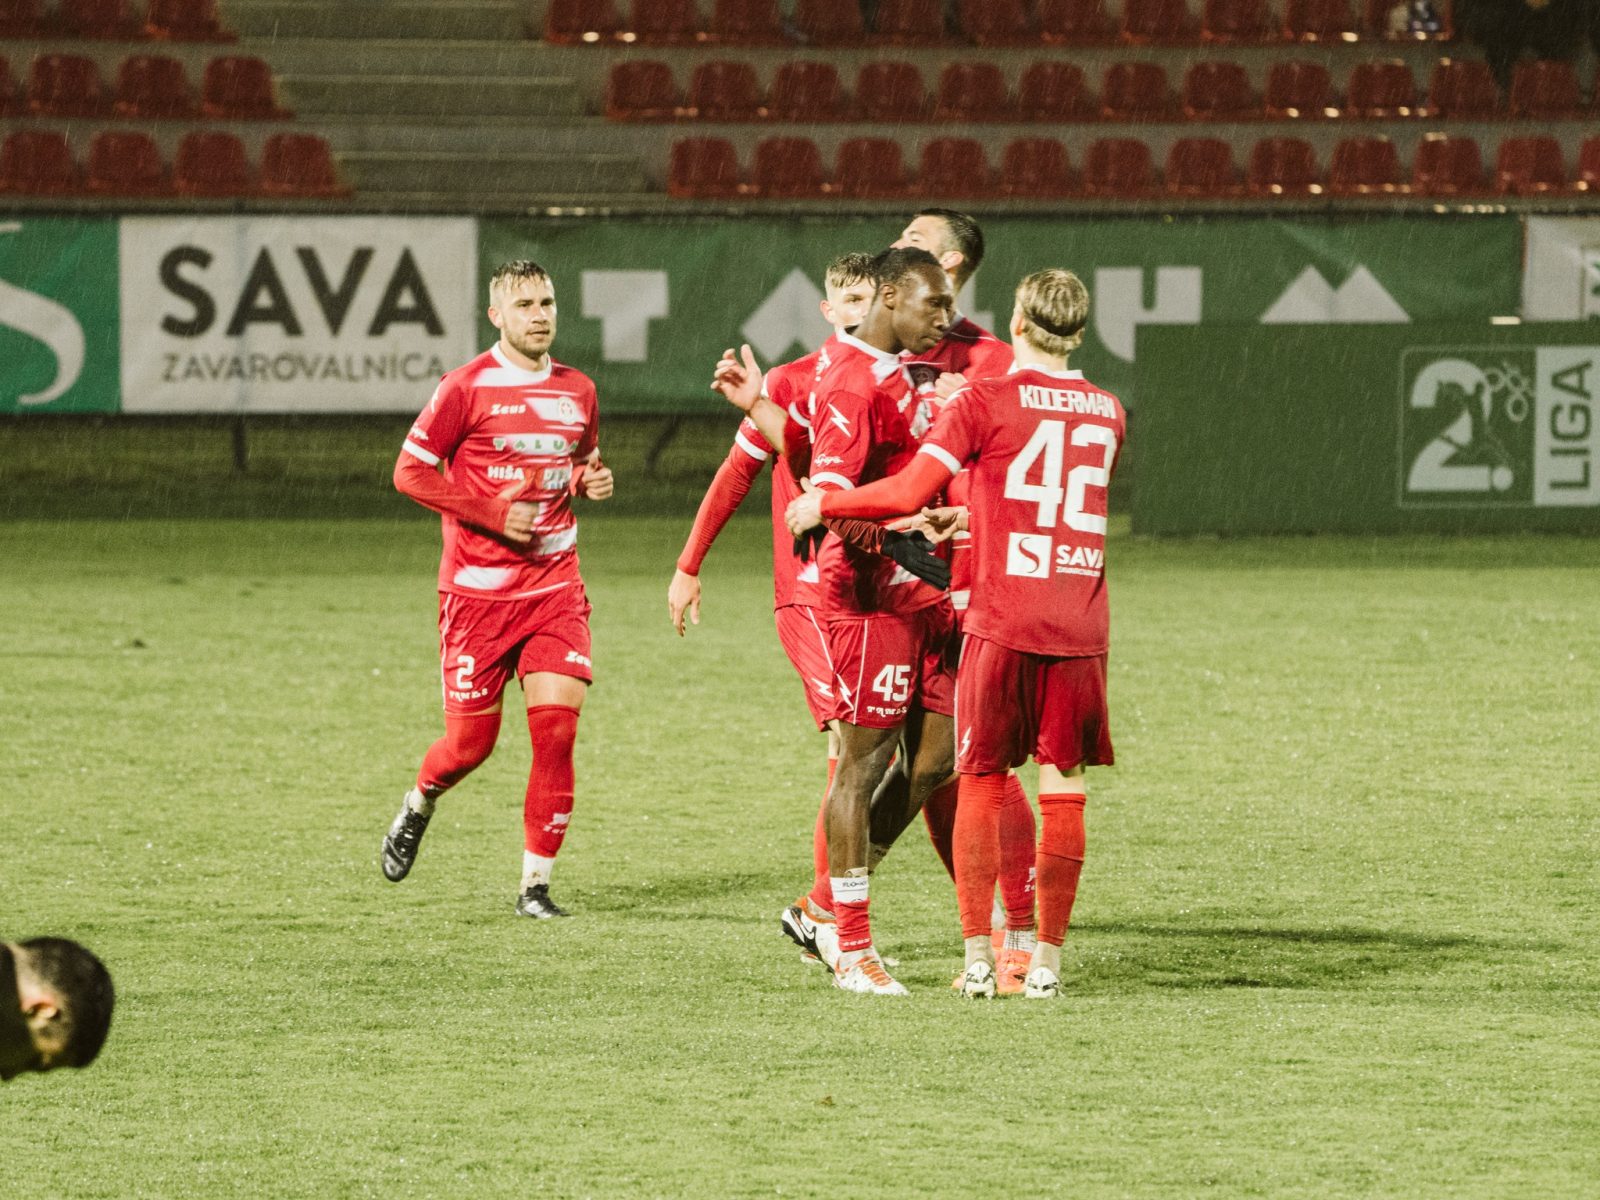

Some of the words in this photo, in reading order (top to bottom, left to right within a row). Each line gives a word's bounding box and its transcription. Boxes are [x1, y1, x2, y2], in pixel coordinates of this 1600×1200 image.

[159, 244, 446, 338] SAVA
[161, 353, 446, 382] ZAVAROVALNICA
[1550, 360, 1593, 490] LIGA
[1004, 419, 1117, 536] 42
[456, 655, 476, 690] 2
[872, 664, 911, 702] 45
